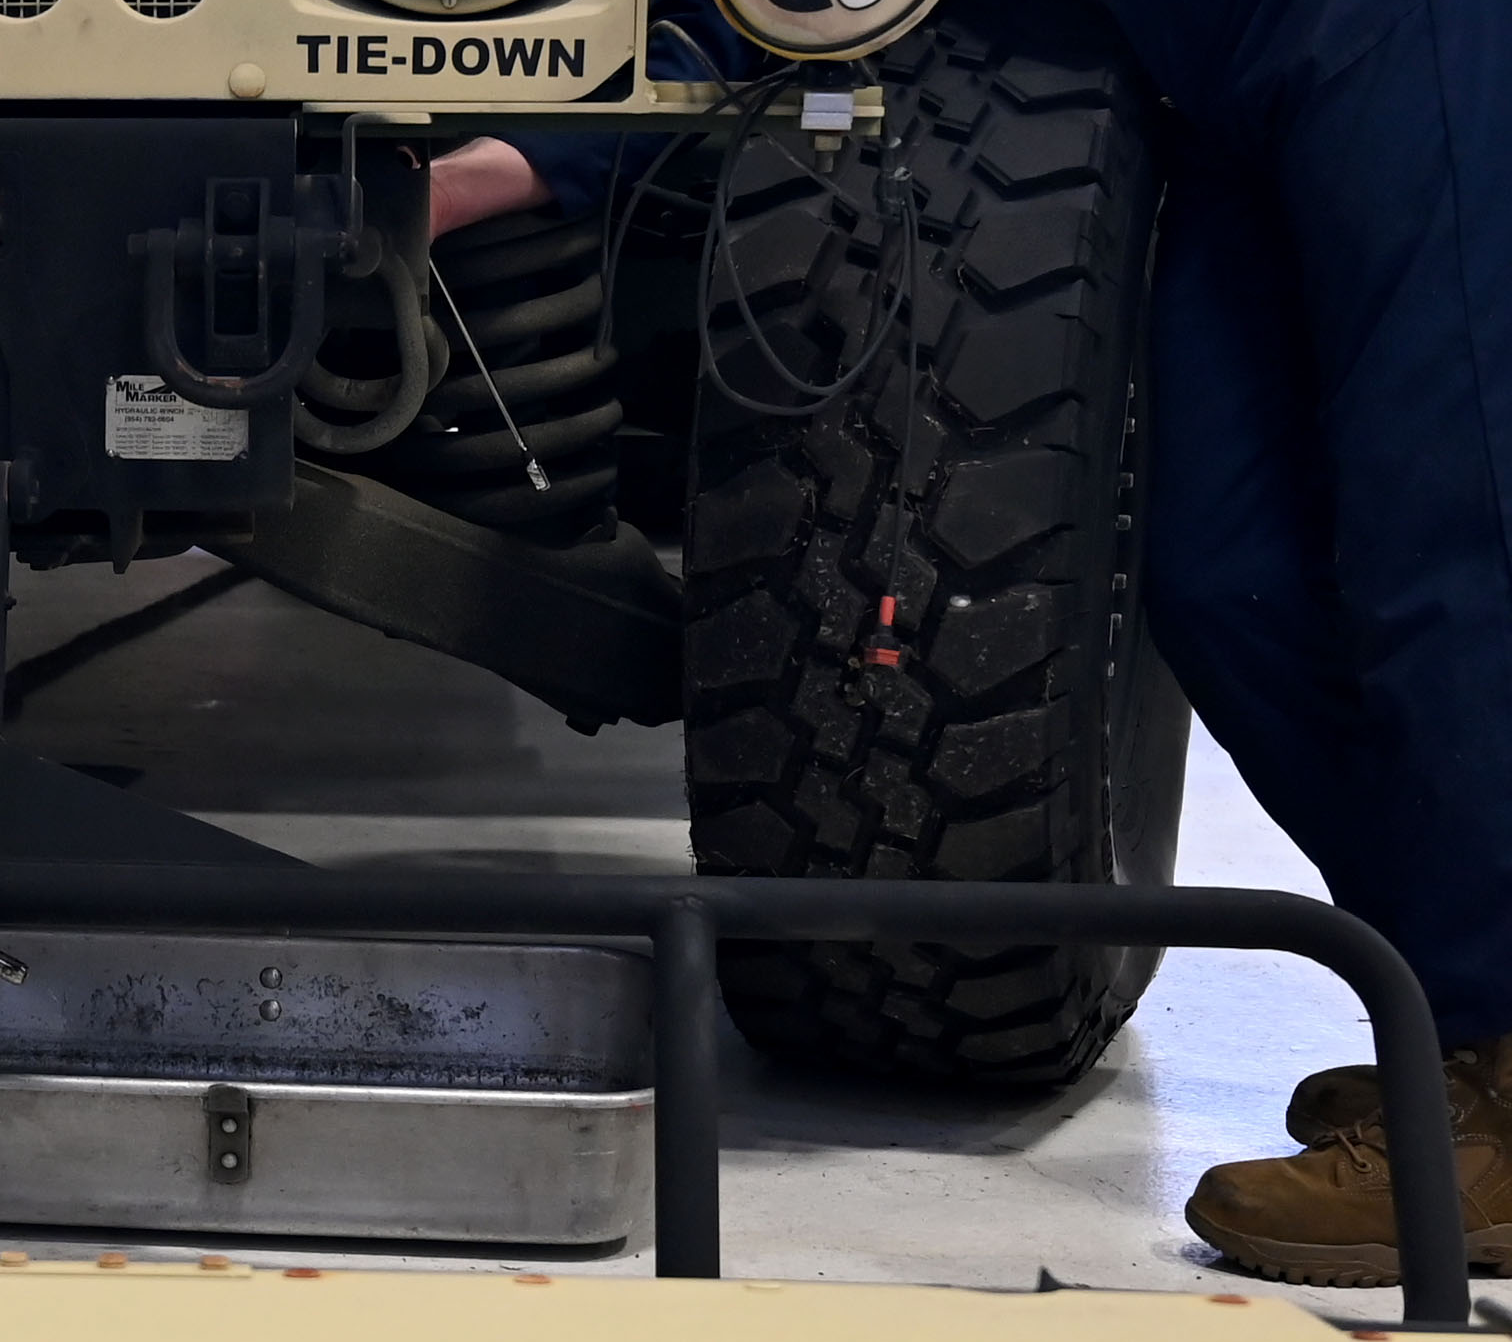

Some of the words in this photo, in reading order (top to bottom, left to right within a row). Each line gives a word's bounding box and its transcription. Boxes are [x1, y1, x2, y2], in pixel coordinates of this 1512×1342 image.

[296, 35, 586, 77] TIE-DOWN
[116, 381, 144, 392] MILE
[126, 392, 176, 402] MARKER
